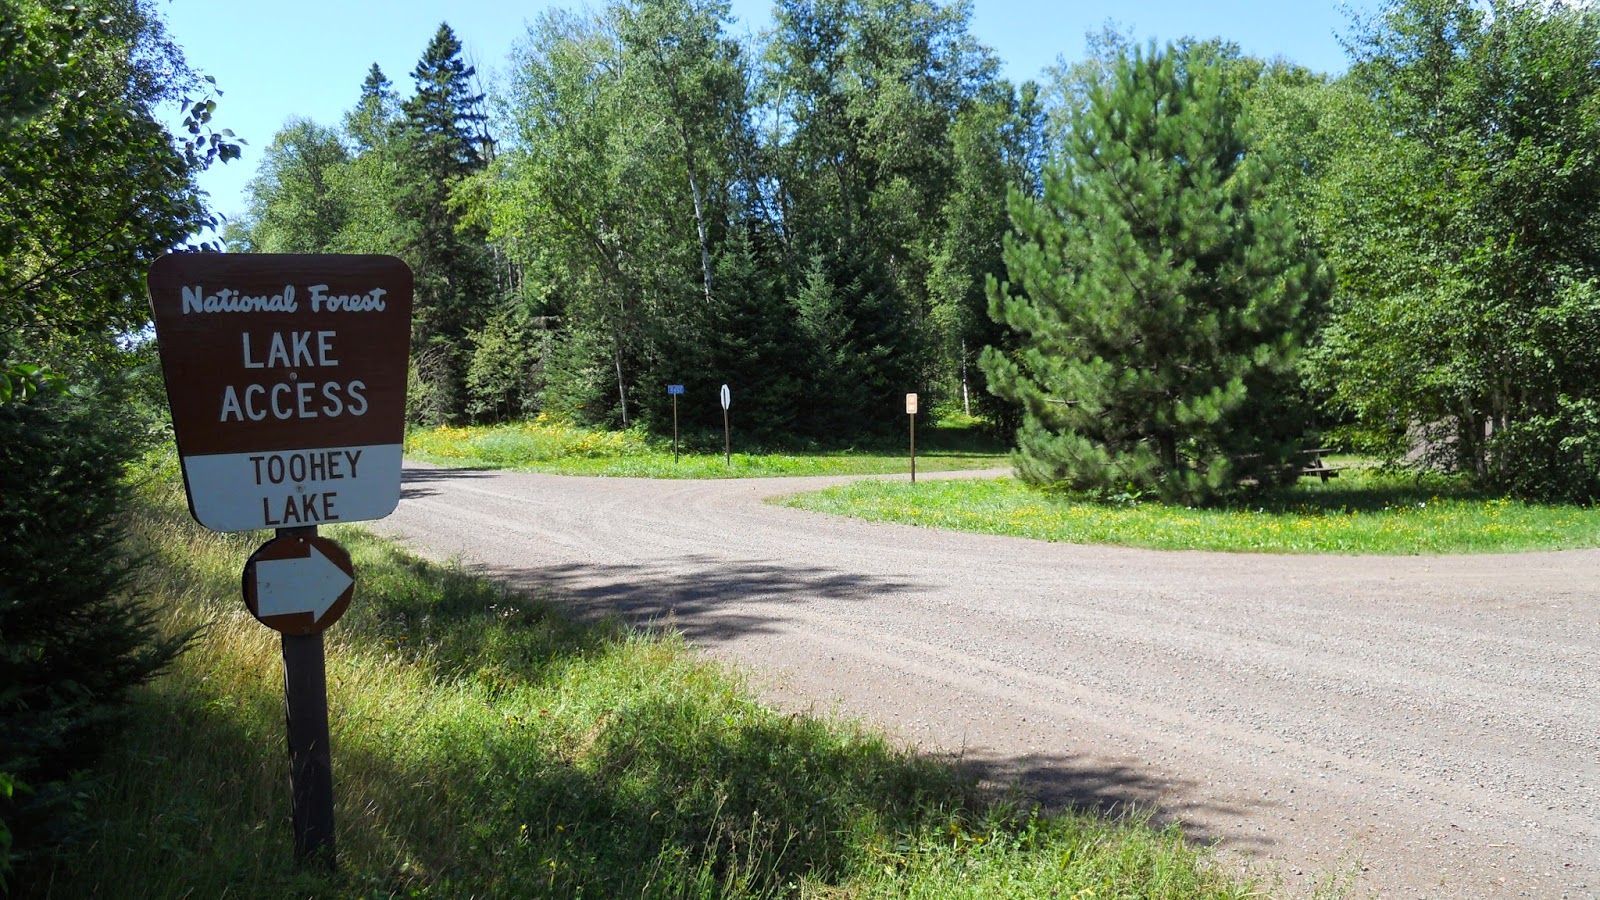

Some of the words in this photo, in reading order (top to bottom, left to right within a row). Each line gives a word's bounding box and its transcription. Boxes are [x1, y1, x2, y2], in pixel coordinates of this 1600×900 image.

[181, 285, 298, 315] National
[308, 284, 387, 313] Forest
[242, 331, 339, 369] LAKE
[220, 380, 369, 422] ACCESS
[249, 450, 363, 486] TOOHEY
[263, 492, 340, 526] LAKE
